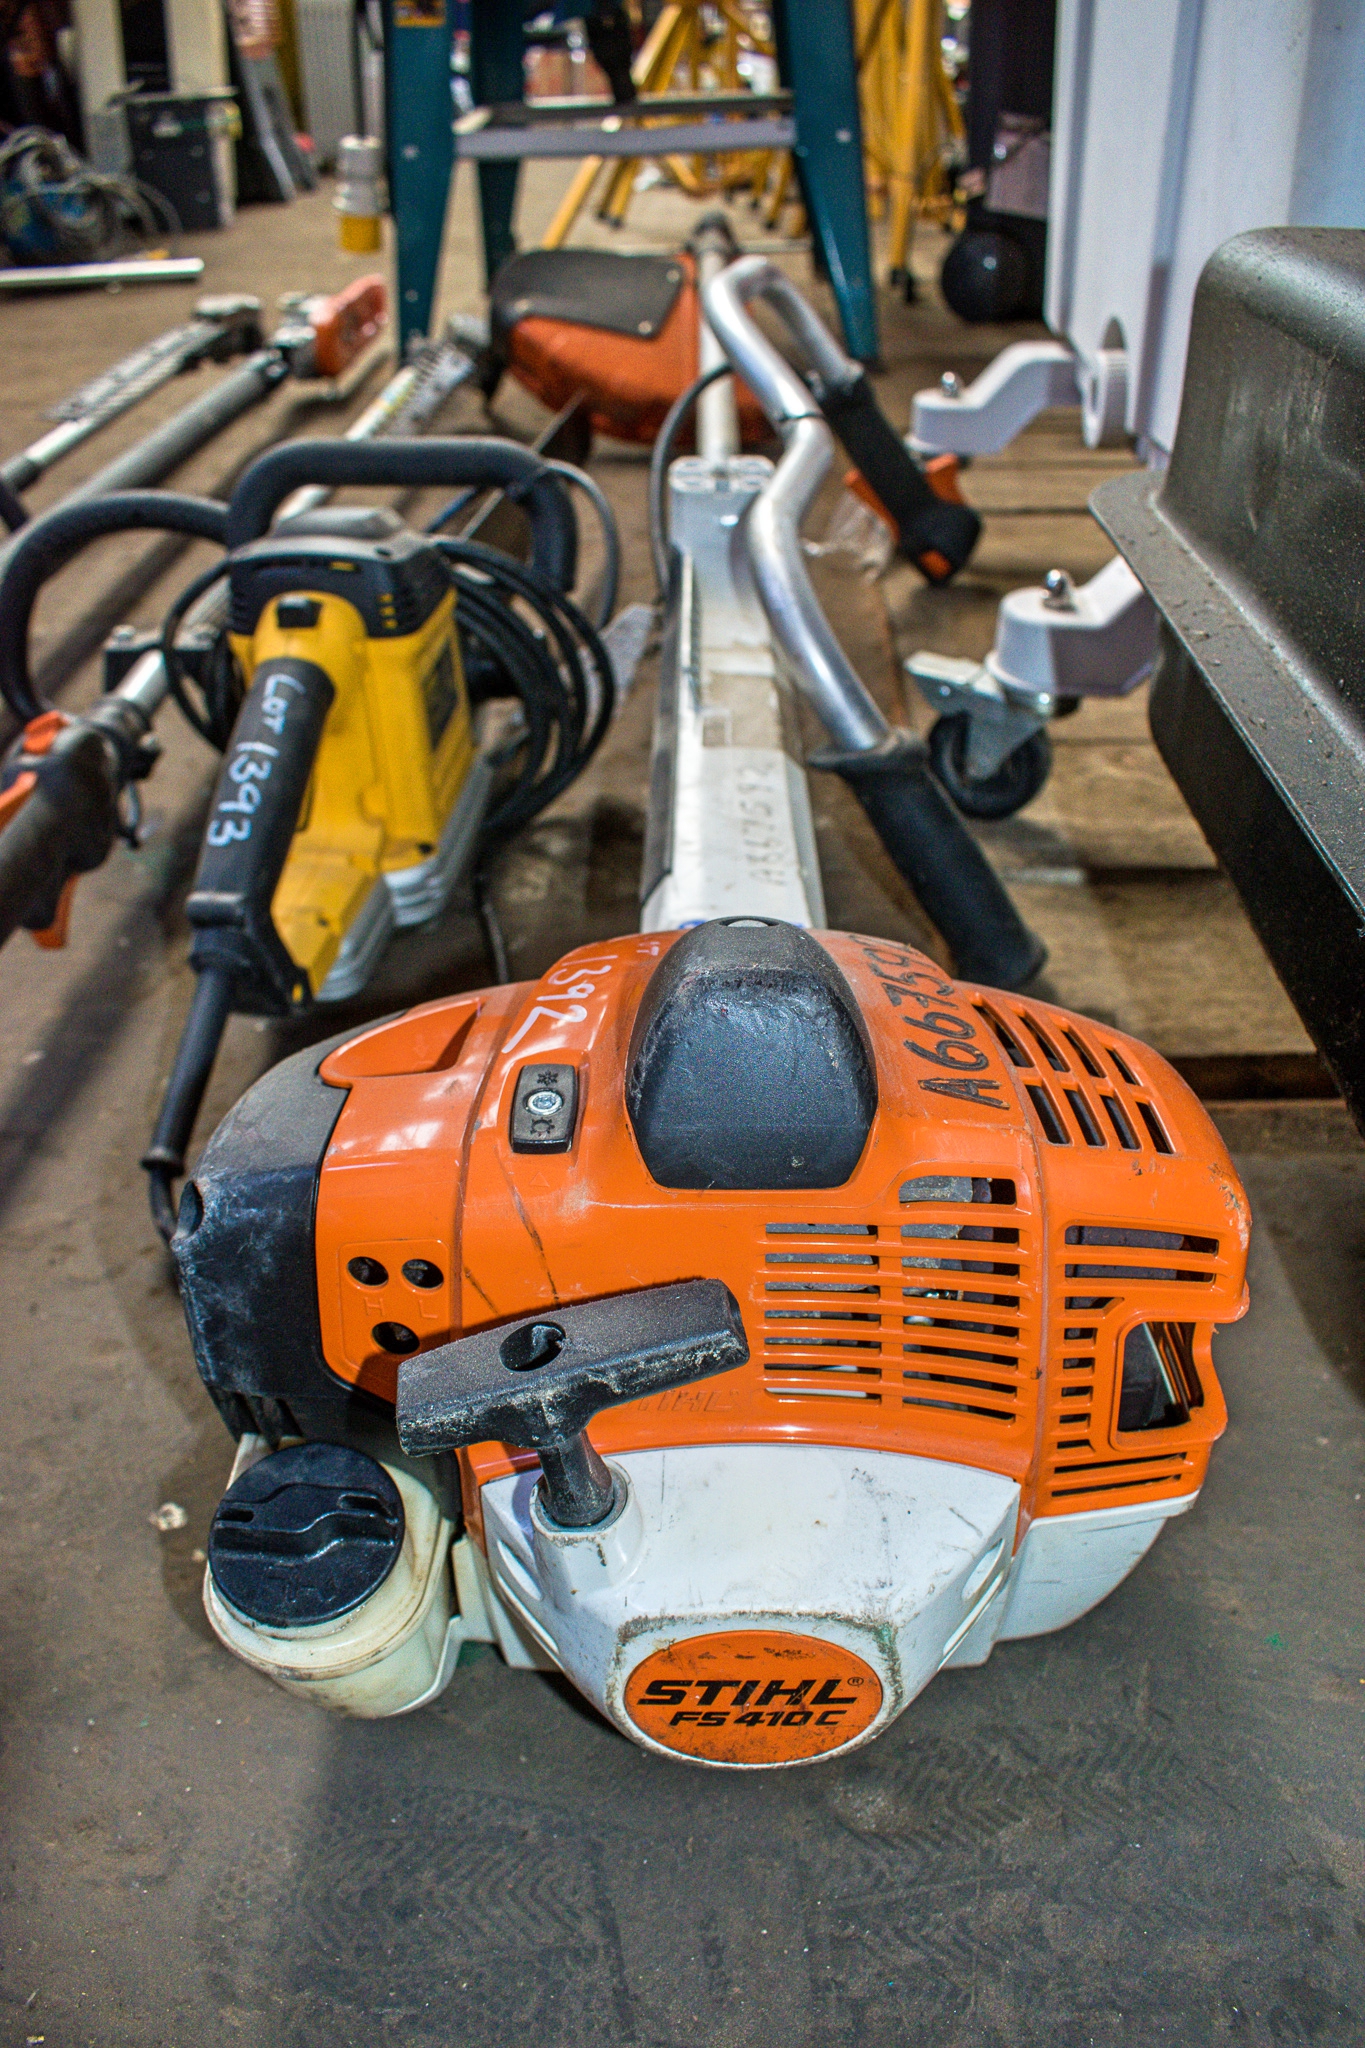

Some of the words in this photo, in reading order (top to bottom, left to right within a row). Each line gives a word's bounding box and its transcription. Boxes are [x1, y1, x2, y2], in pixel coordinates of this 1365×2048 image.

[207, 741, 280, 847] 1393
[501, 955, 618, 1054] 1392
[669, 1711, 730, 1727] FS
[734, 1710, 810, 1727] 410
[815, 1709, 847, 1726] C
